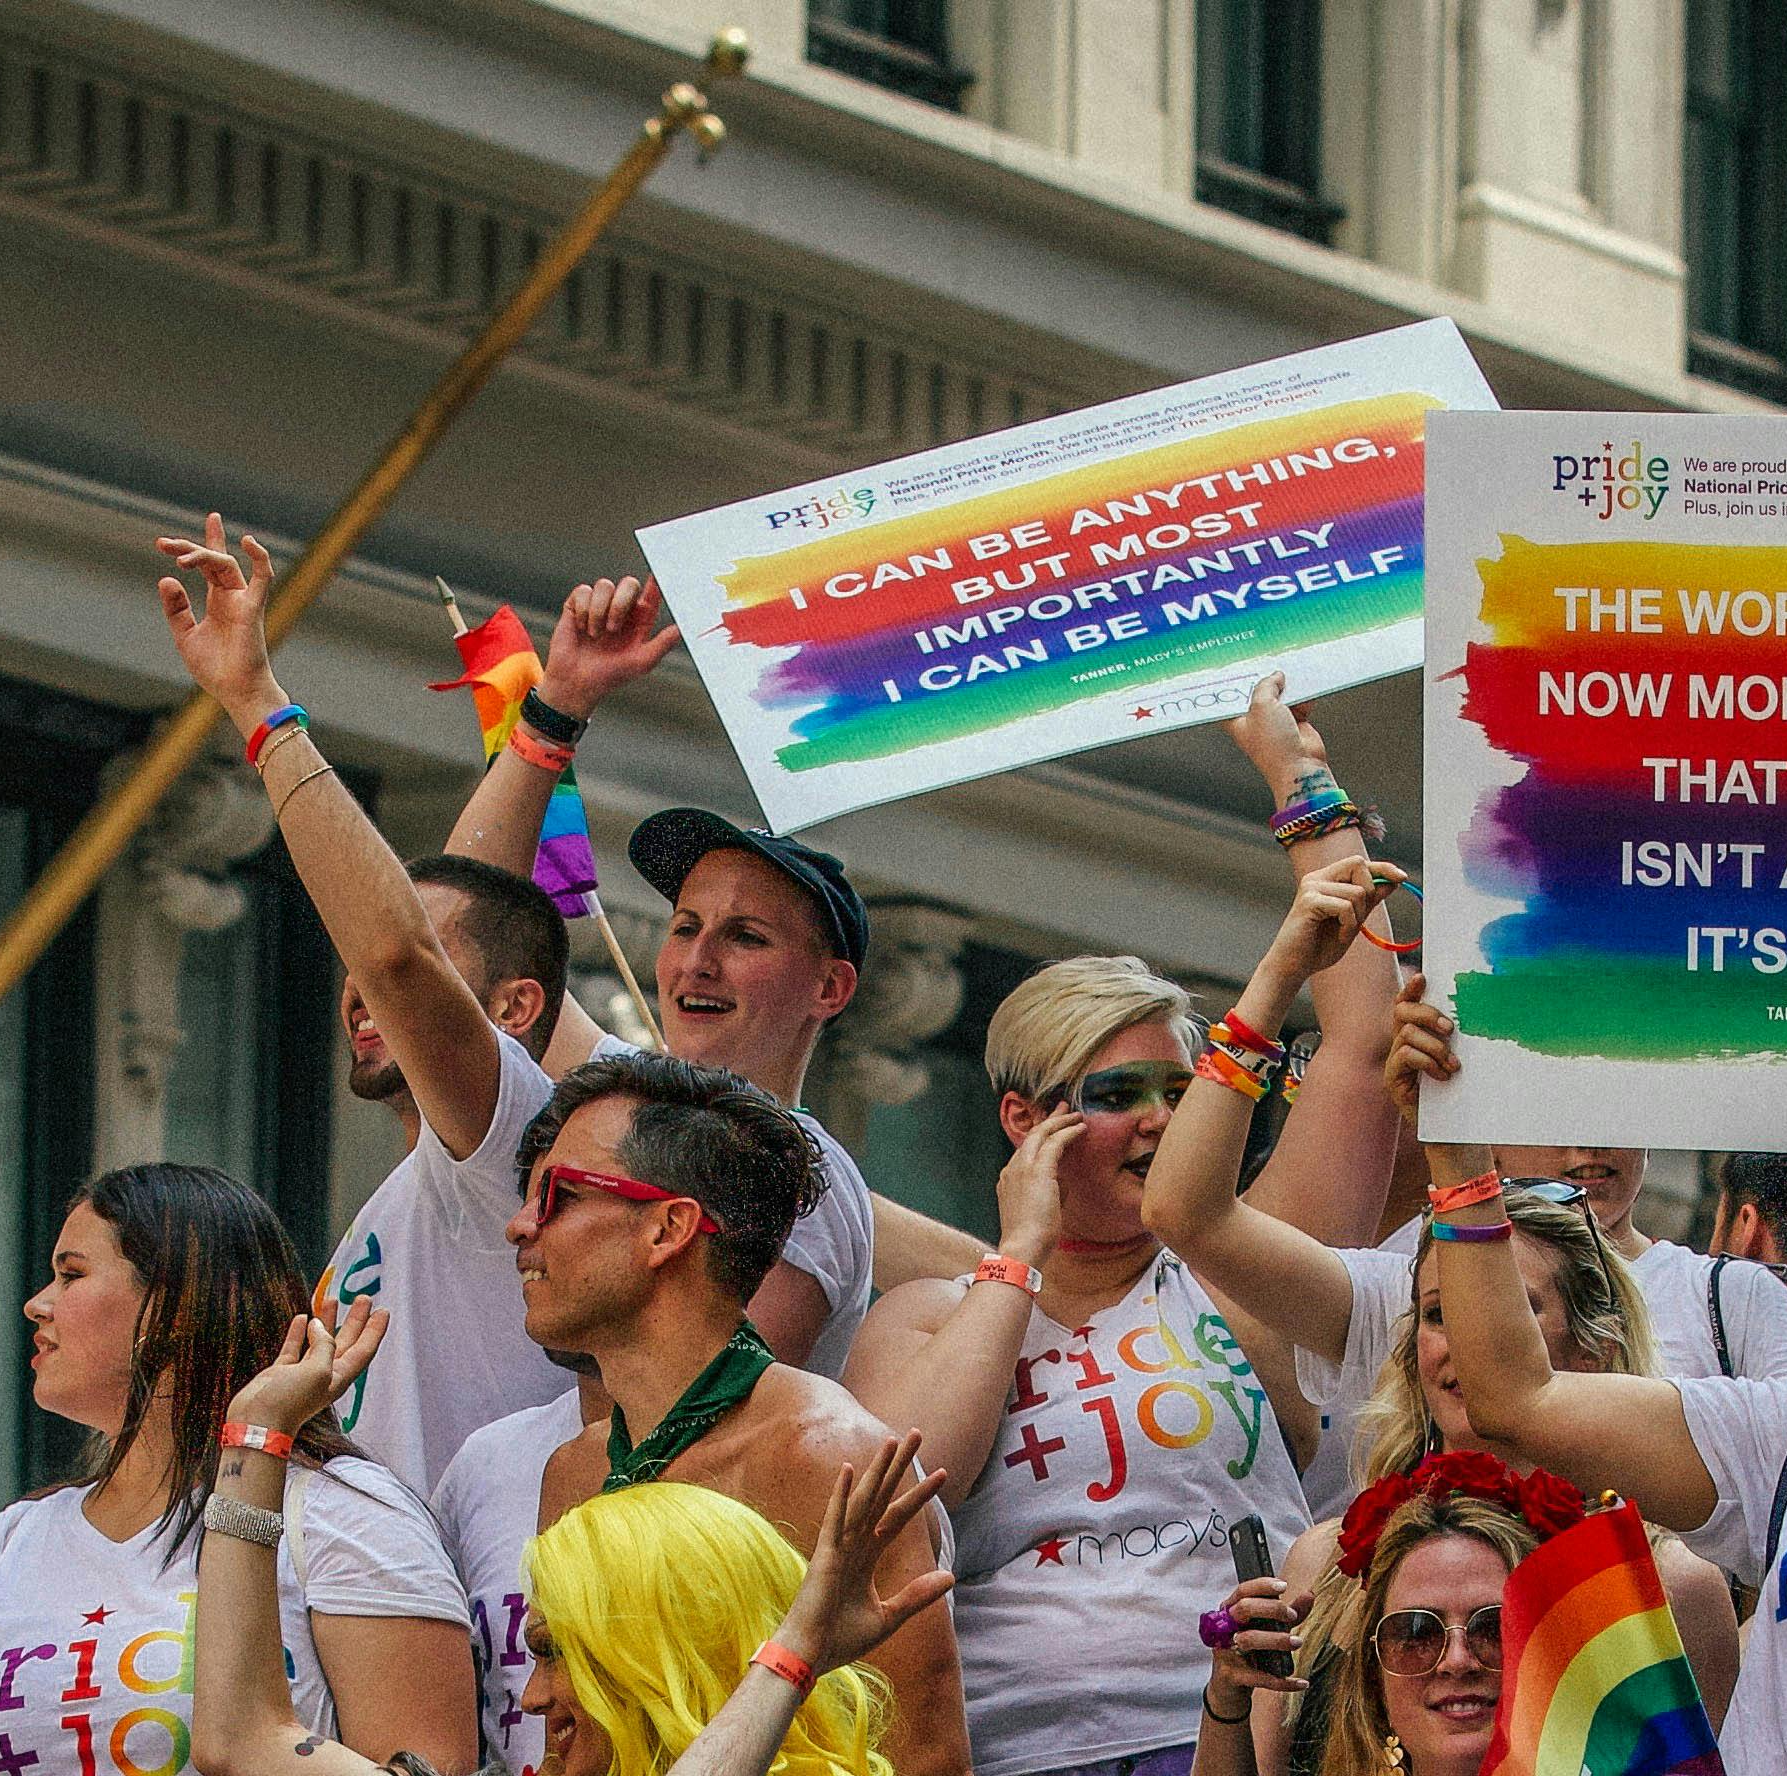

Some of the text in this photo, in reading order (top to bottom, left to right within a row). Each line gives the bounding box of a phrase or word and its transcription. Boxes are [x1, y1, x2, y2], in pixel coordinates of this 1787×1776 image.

[1553, 441, 1670, 490] pride
[1684, 457, 1708, 473] We
[1713, 461, 1737, 473] are
[1742, 458, 1787, 477] proud
[1684, 479, 1752, 495] National
[766, 485, 875, 534] pride
[789, 435, 1398, 610] I CAN BE ANYTHING,
[1684, 500, 1722, 519] Plus,
[1726, 500, 1755, 519] join
[1759, 503, 1777, 517] us
[952, 502, 1263, 606] BUT MOST
[913, 521, 1337, 655] IMPORTANTLY
[1554, 586, 1663, 634] THE
[883, 545, 1406, 704] I CAN BE MYSELF
[1538, 671, 1673, 718] NOW
[1621, 840, 1765, 889] ISN'T
[1078, 1508, 1228, 1566] macy's
